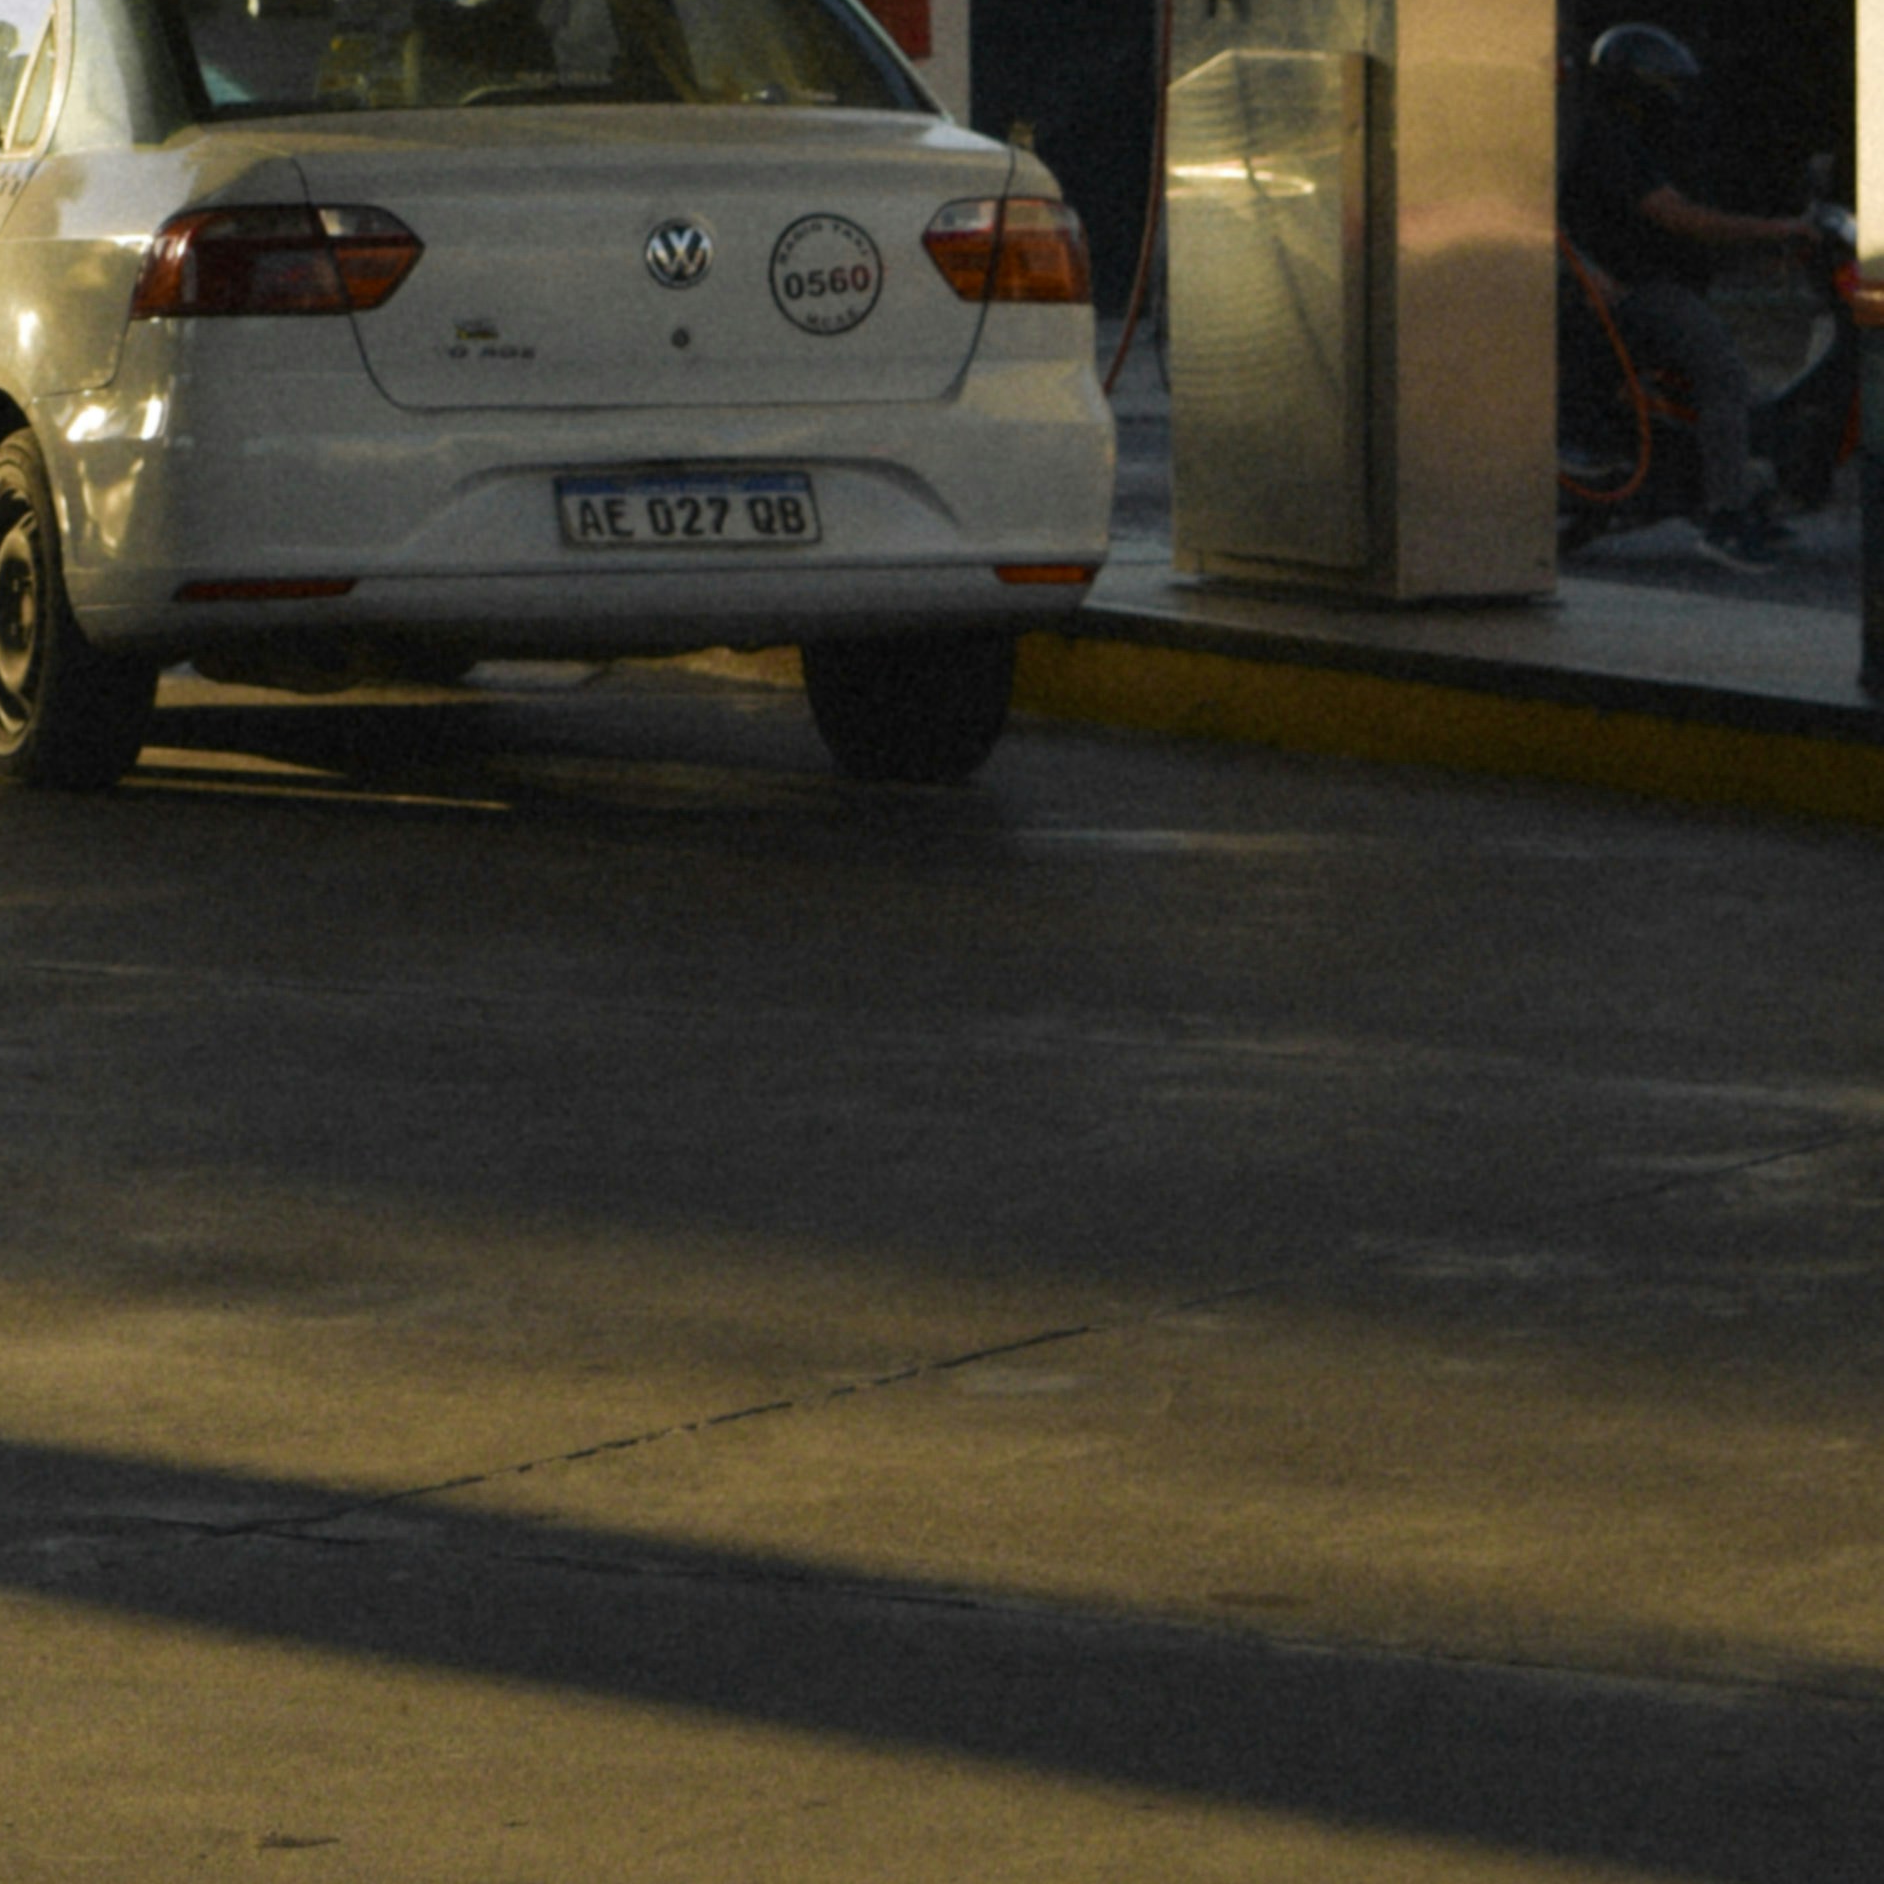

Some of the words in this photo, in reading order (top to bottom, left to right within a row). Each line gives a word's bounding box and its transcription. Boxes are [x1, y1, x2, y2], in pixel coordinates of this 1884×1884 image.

[784, 264, 871, 300] 0560
[578, 498, 634, 538] AE
[646, 497, 729, 536] 027
[746, 495, 806, 535] QB
